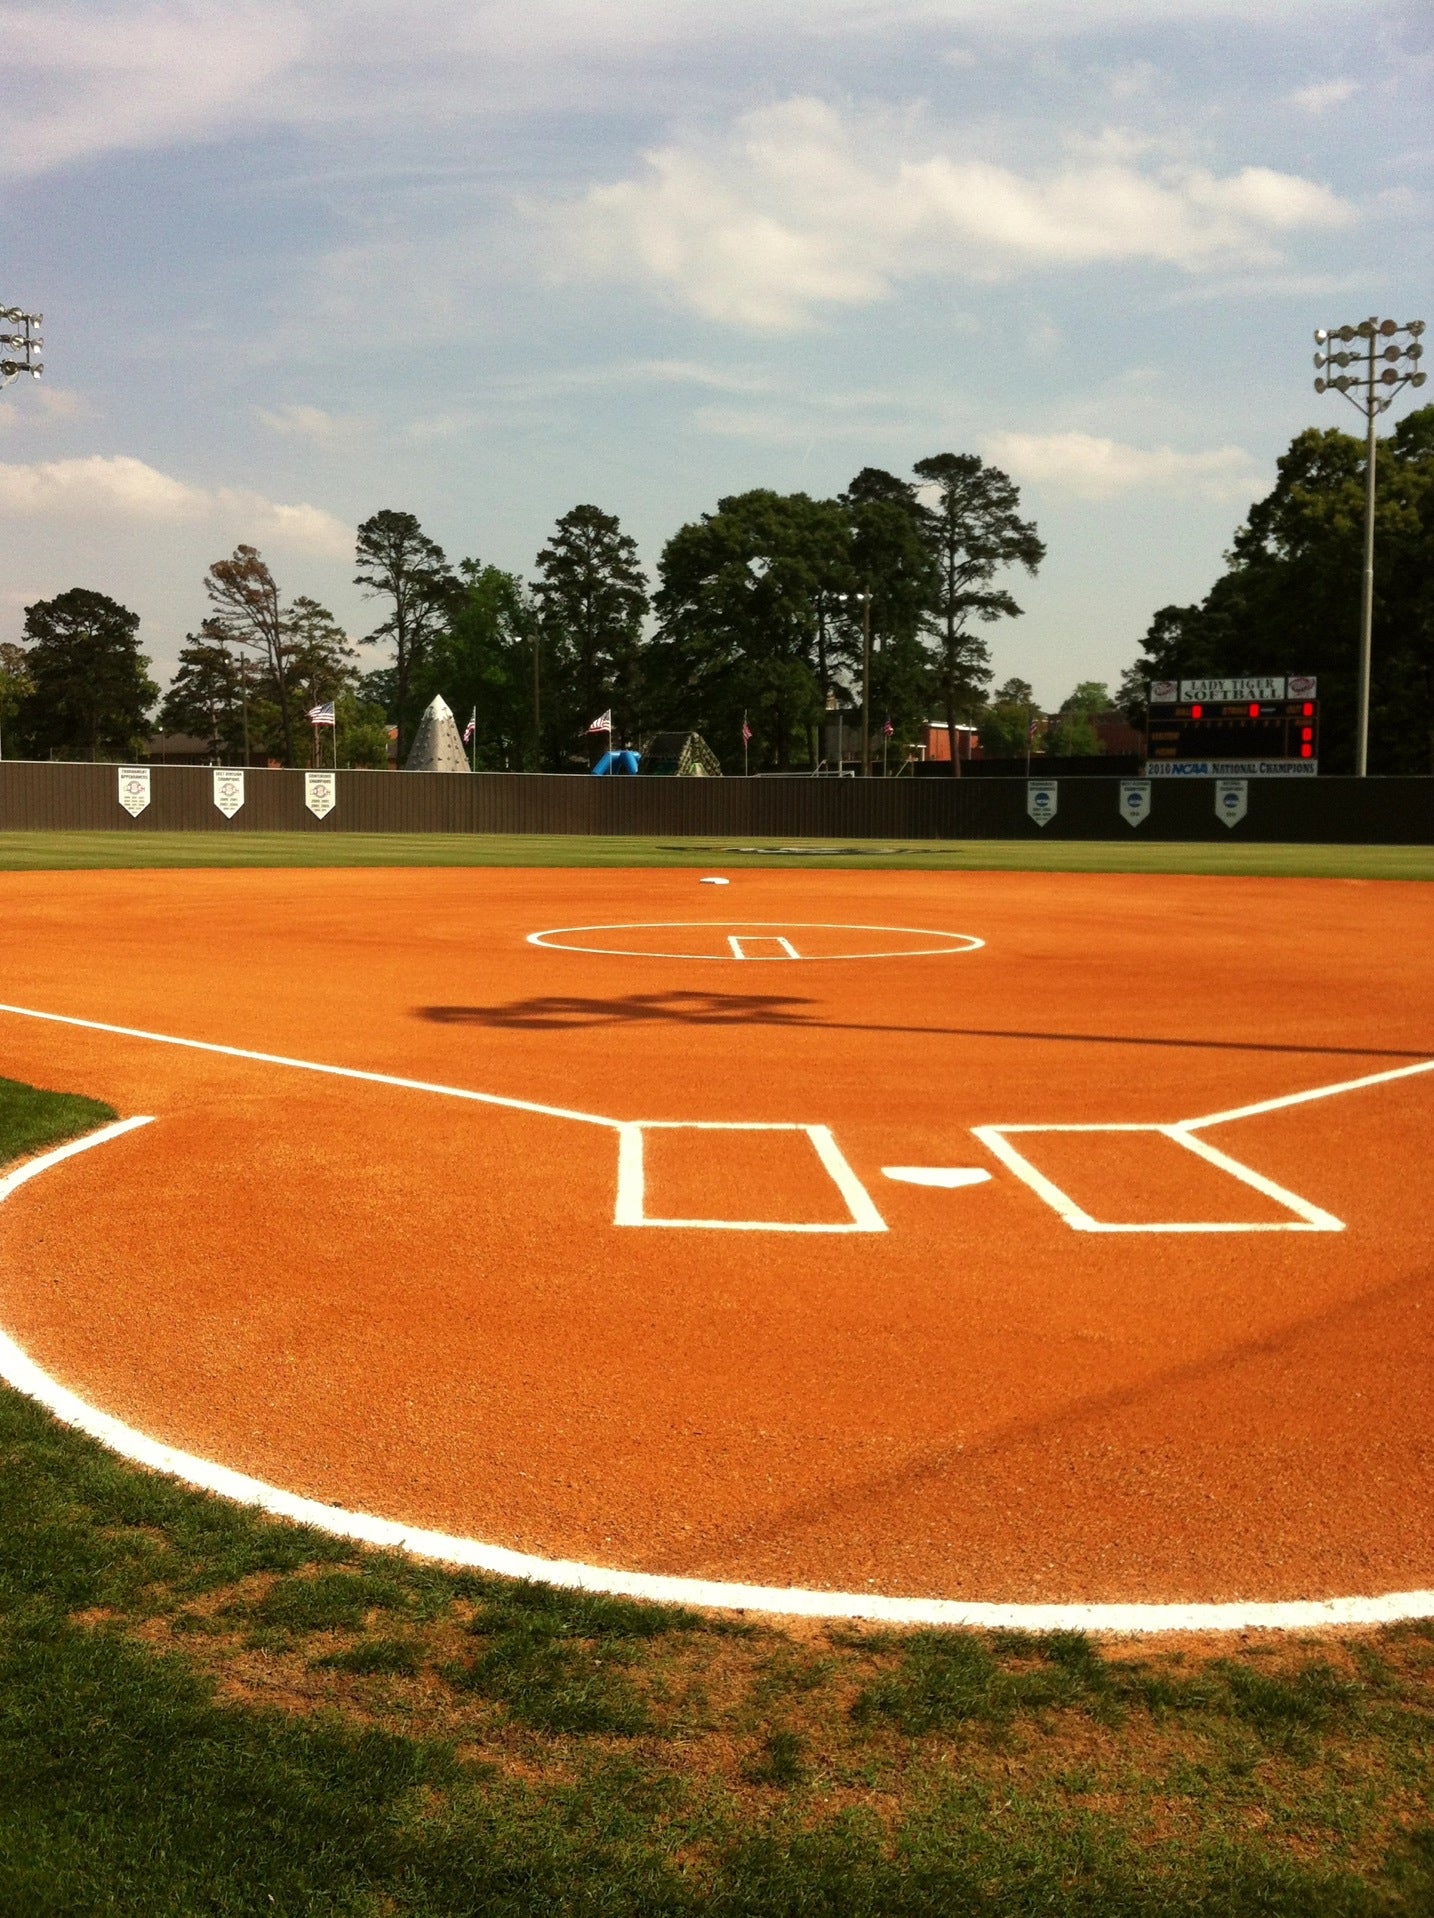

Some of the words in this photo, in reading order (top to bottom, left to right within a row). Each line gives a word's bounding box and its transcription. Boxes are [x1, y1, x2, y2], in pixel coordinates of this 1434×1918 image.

[1191, 680, 1225, 690] LADY
[1232, 678, 1275, 690] TIGER
[1184, 689, 1283, 701] SOFTBALL
[1171, 763, 1208, 775] NCAA
[1212, 763, 1257, 774] NATIONAL
[1260, 762, 1315, 774] CHAMPIONS
